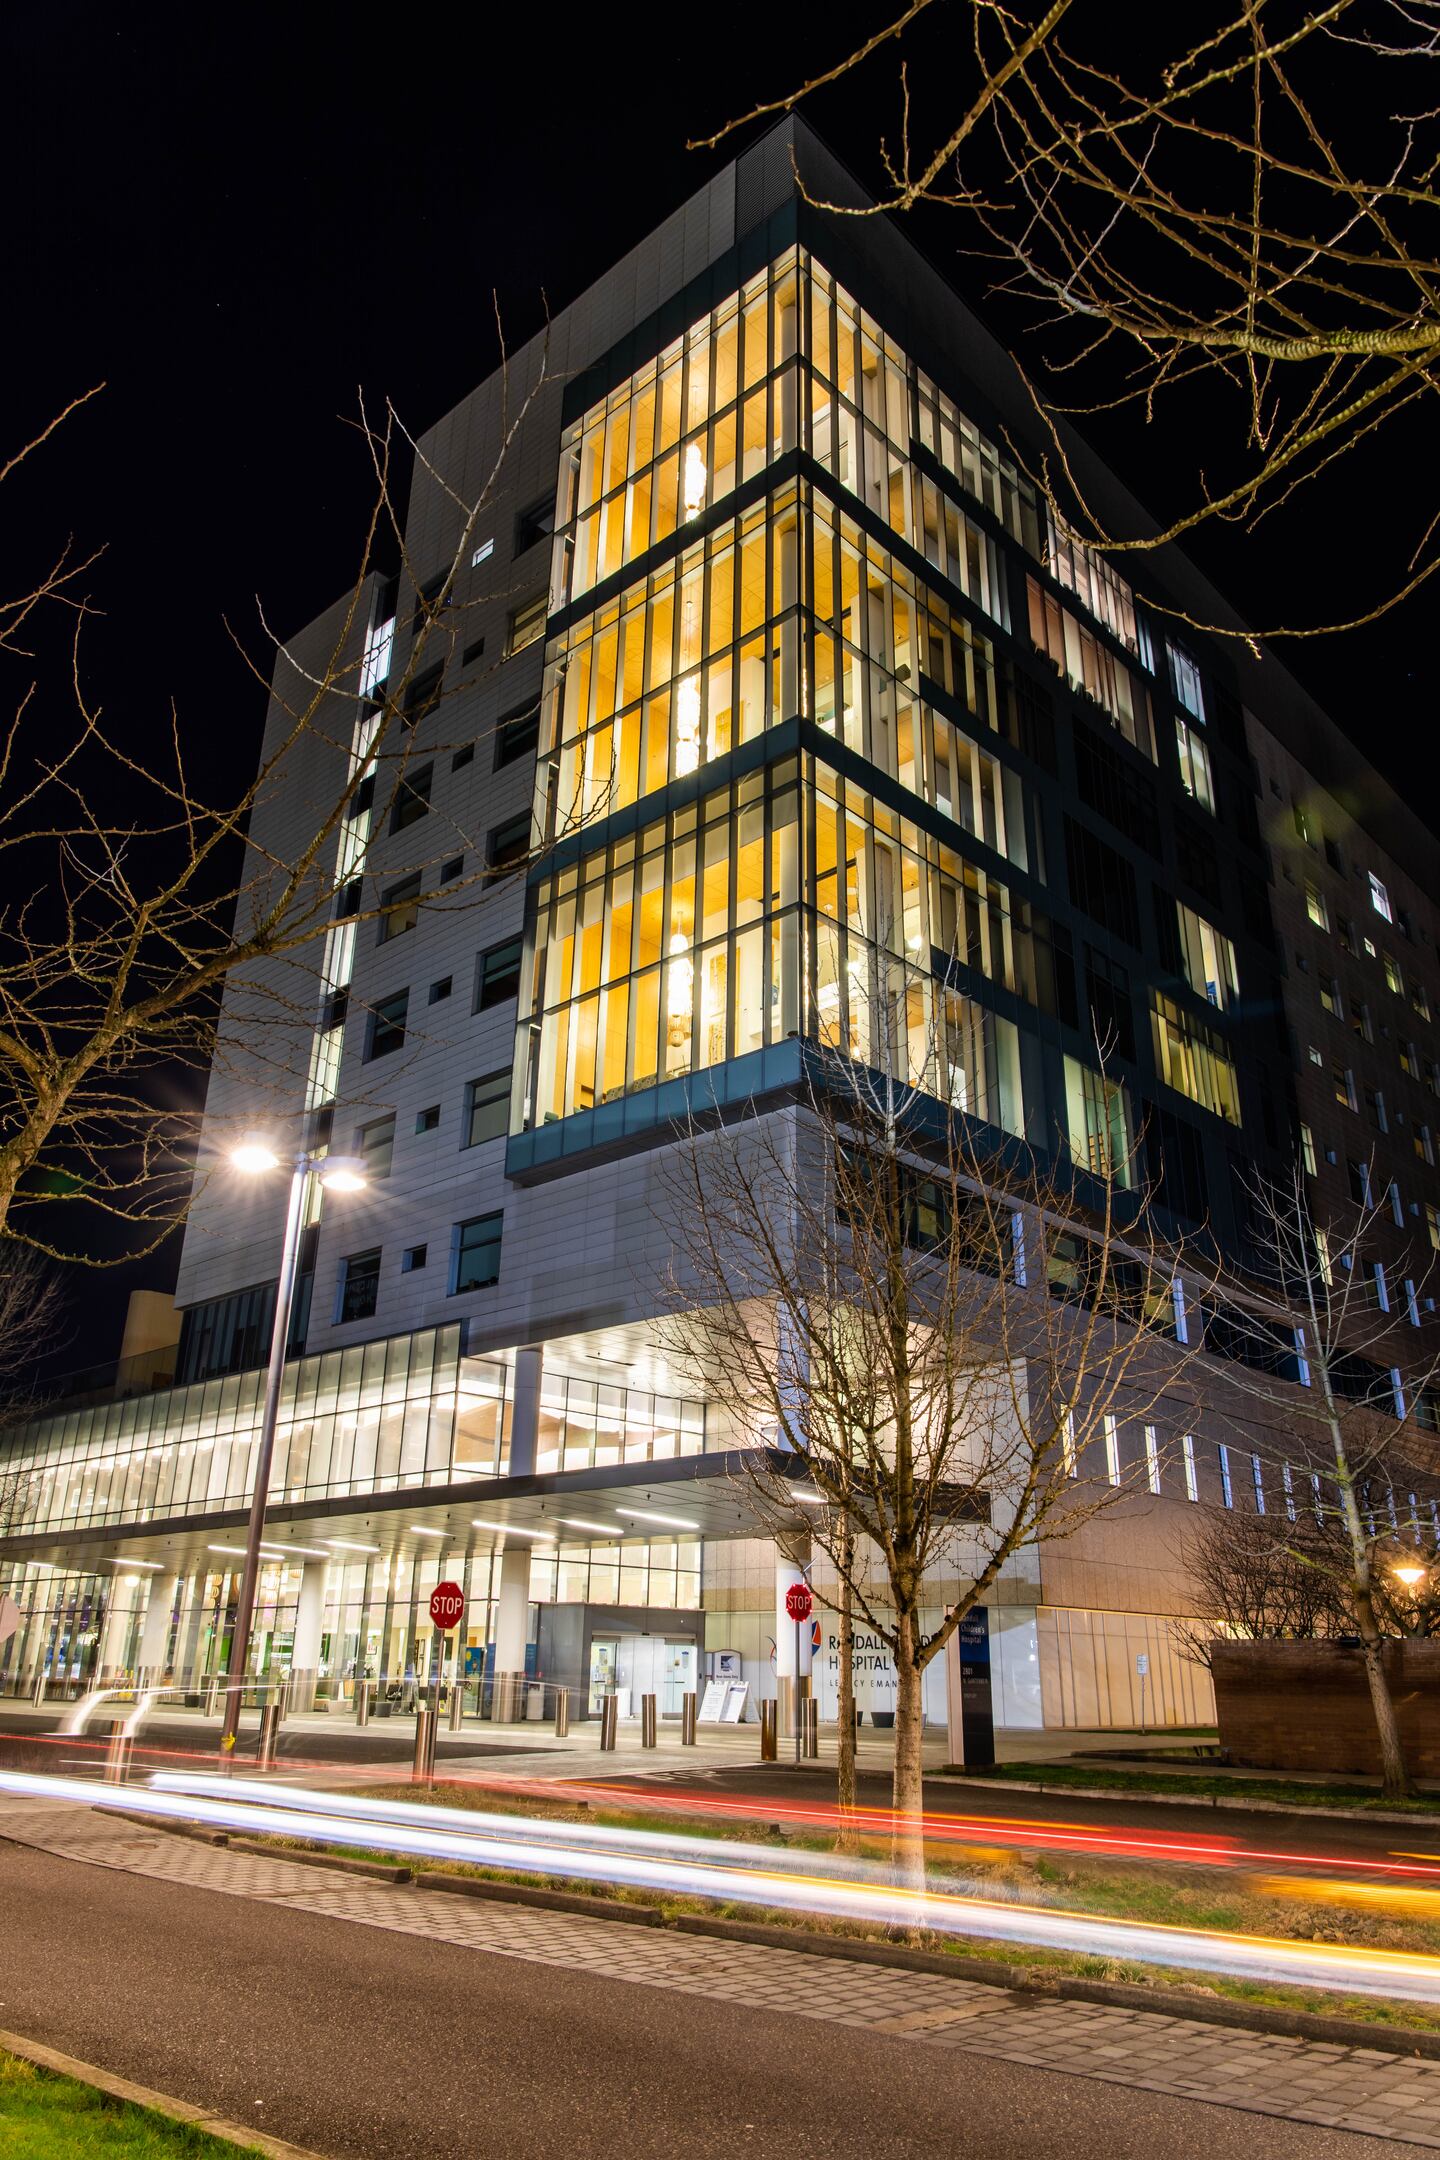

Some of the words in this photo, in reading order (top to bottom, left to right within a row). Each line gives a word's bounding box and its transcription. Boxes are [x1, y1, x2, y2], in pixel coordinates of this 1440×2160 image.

[432, 1596, 462, 1615] STOP
[787, 1595, 810, 1610] STOP
[829, 1635, 887, 1650] RDALL
[829, 1655, 890, 1671] HSPITAL
[830, 1679, 865, 1688] LECY
